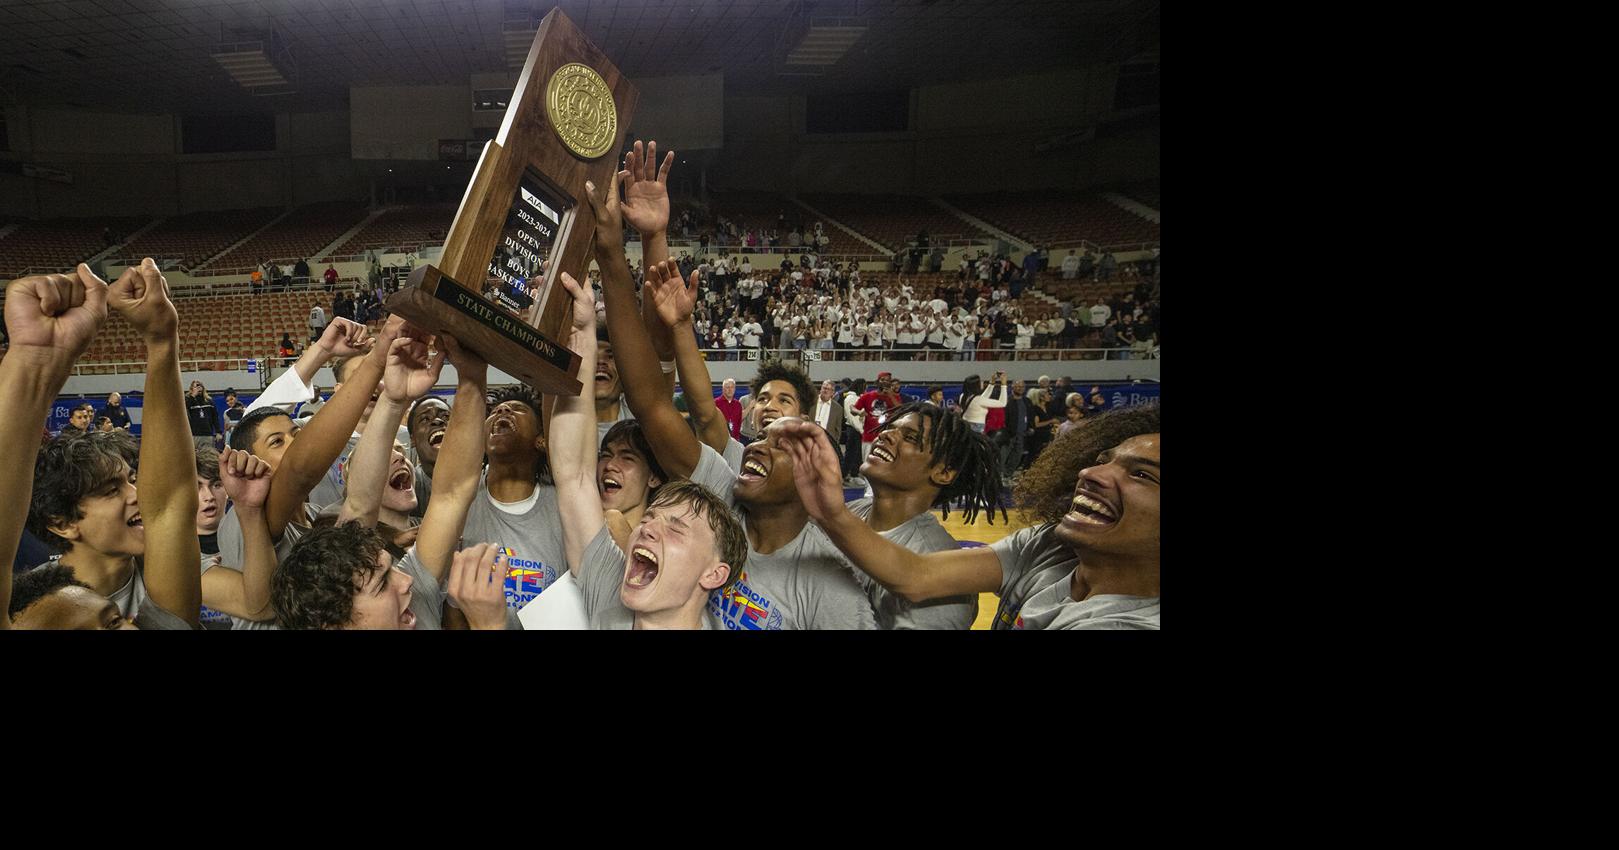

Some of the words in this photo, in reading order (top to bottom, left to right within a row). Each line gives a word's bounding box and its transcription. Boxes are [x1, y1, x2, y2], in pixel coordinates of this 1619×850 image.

[527, 196, 542, 210] AIA
[517, 209, 551, 237] 2023-2024
[505, 237, 543, 267] DIVISION
[517, 230, 540, 250] OPEN
[507, 258, 530, 279] BOYS
[457, 292, 494, 320] STATE
[494, 316, 556, 358] CHAMPIONS
